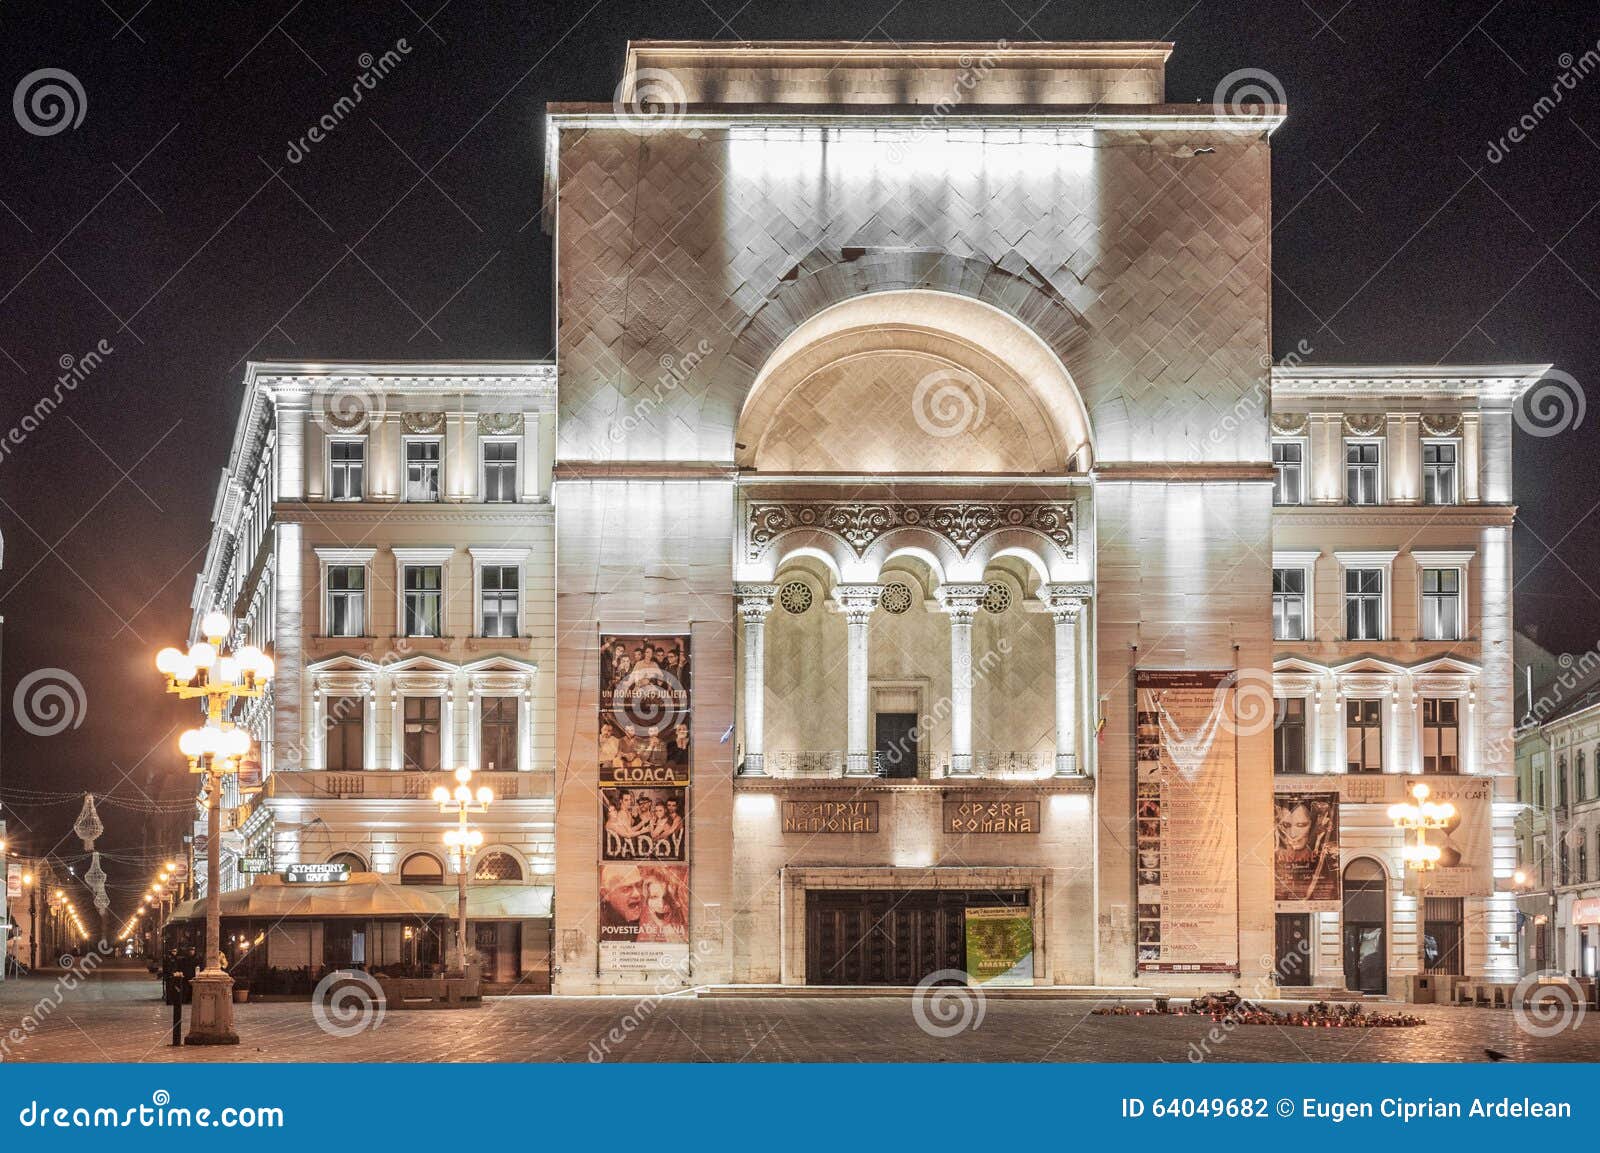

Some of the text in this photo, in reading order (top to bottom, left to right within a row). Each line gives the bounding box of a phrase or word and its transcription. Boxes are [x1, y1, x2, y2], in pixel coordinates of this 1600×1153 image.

[613, 767, 675, 781] CLOACA
[959, 802, 1025, 816] OPERA
[952, 817, 1031, 832] ROMANA
[605, 827, 684, 858] DADDY
[291, 864, 345, 872] SYMPHONY
[601, 926, 644, 934] POVESTEA
